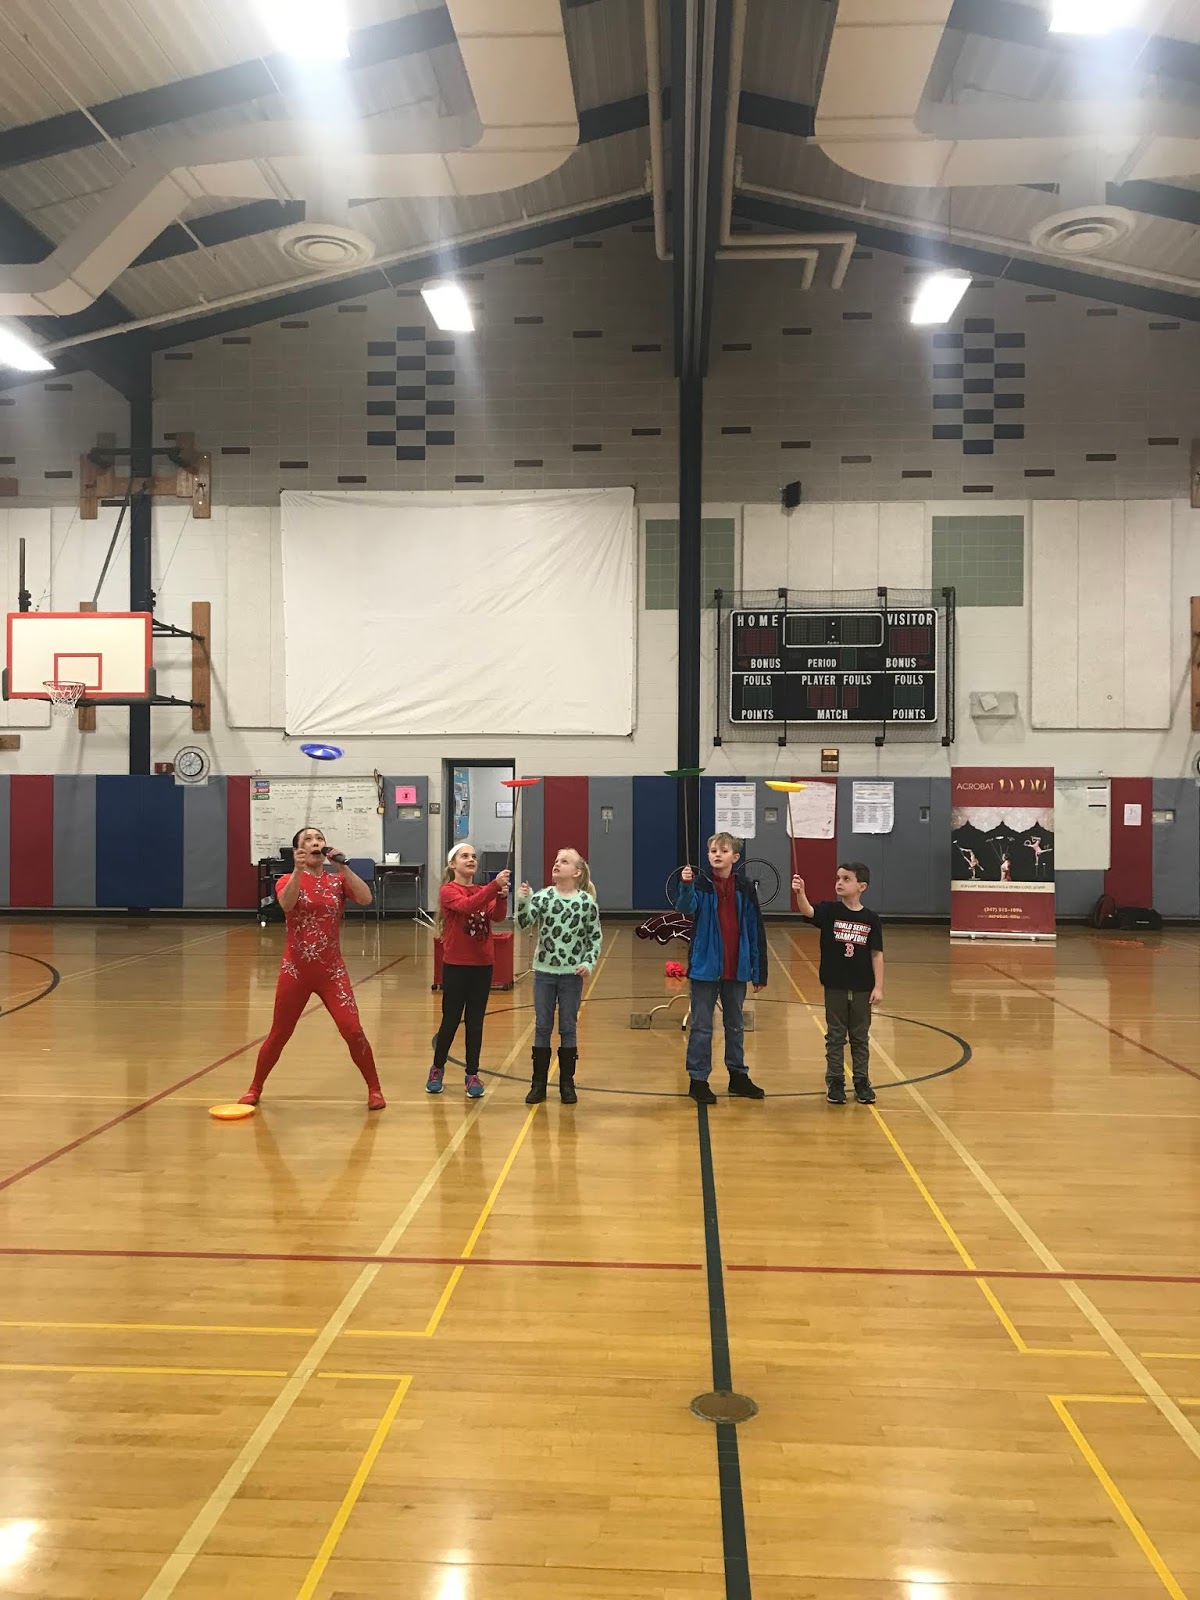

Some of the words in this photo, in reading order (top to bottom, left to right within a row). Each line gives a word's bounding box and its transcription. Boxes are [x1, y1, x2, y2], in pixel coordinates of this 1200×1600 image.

[737, 615, 779, 627] HOME
[887, 613, 933, 626] VISITOR
[750, 658, 781, 669] BONUS
[807, 658, 837, 668] PERIOD
[885, 657, 917, 668] BONUS
[743, 675, 772, 685] FOULS
[801, 675, 836, 685] PLAYER
[843, 675, 872, 685] FOULS
[894, 674, 924, 685] FOULS
[741, 709, 774, 720] POINTS
[817, 709, 848, 720] MATCH
[892, 709, 926, 719] POINTS
[956, 782, 995, 790] ACROBAT
[833, 921, 852, 930] WORLD
[844, 942, 855, 958] B
